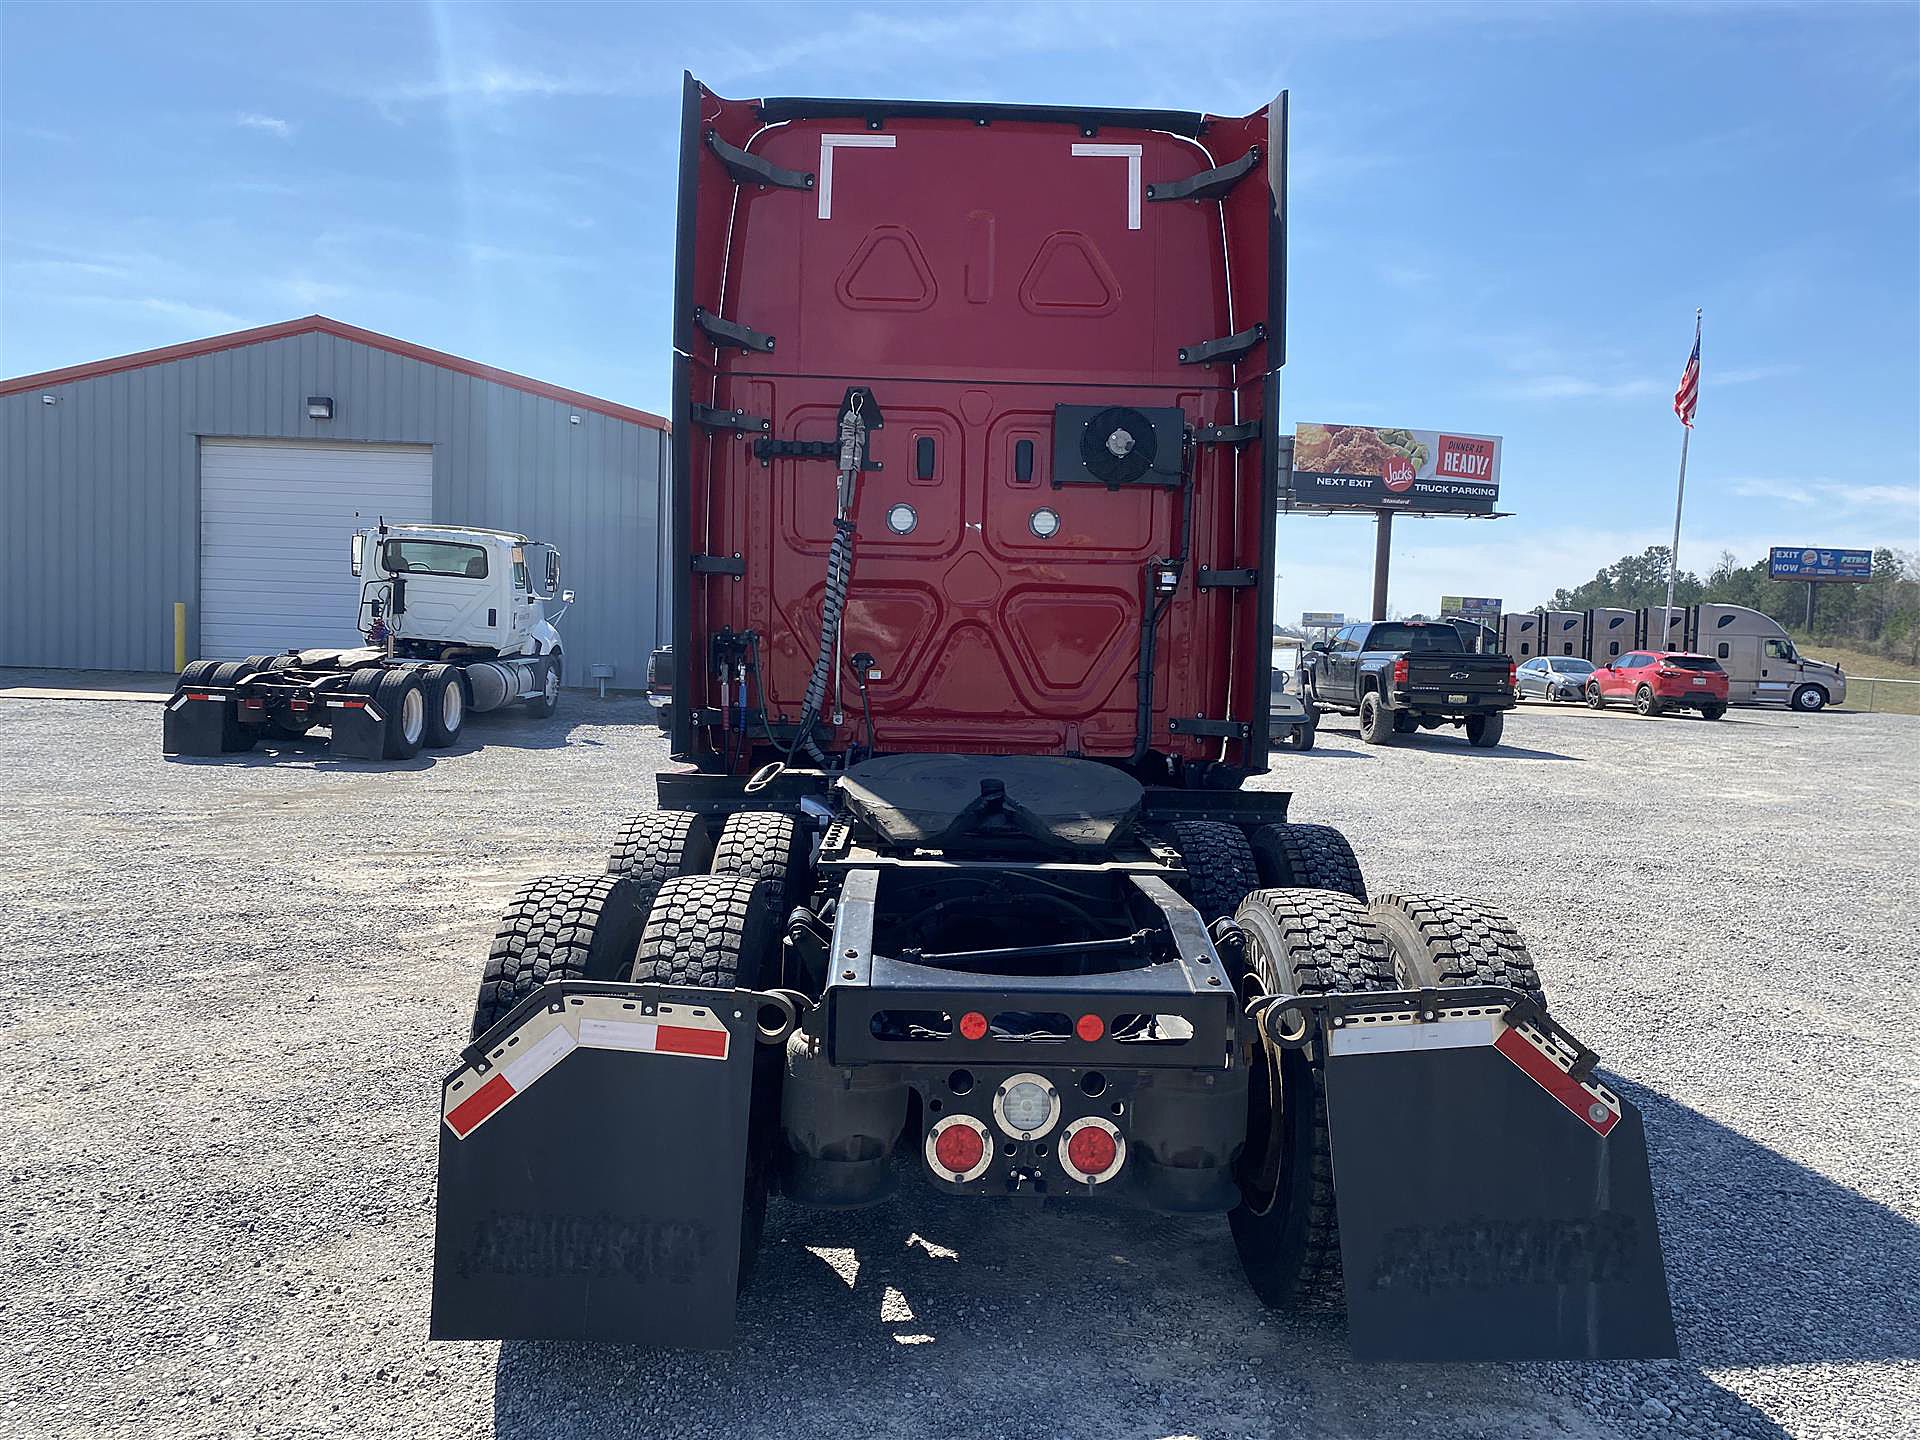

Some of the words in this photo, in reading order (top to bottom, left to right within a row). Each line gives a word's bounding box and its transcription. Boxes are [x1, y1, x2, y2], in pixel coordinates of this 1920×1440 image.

[1448, 440, 1475, 452] DINNER
[1443, 451, 1490, 475] READY!
[1385, 462, 1413, 483] Jack's
[1316, 477, 1346, 486] NEXT
[1349, 479, 1373, 488] EXIT
[1414, 483, 1449, 493] TRUCK
[1451, 486, 1496, 496] PARKING
[1776, 551, 1800, 559] EXIT
[1775, 564, 1799, 572] NOW
